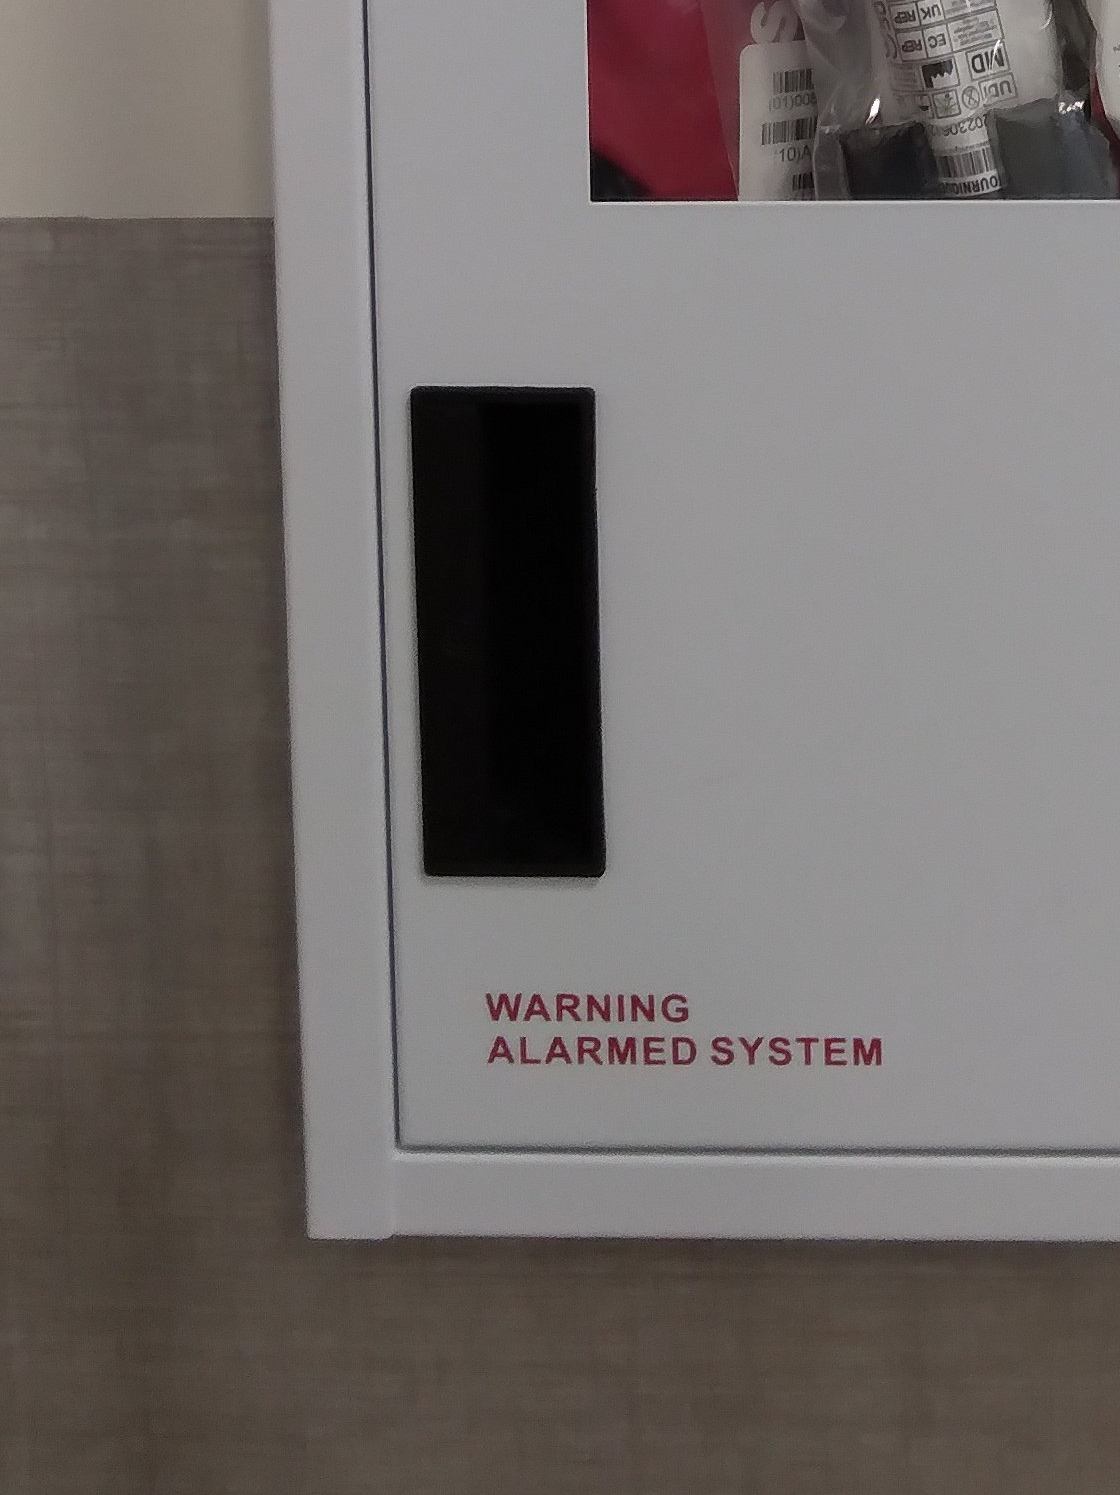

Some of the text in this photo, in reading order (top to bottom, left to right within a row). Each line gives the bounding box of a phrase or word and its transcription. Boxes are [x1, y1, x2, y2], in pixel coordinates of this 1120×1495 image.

[893, 10, 916, 24] REP
[920, 4, 941, 19] UK
[901, 39, 922, 53] REP
[927, 33, 946, 48] EC
[486, 993, 690, 1023] WARNING
[487, 1036, 882, 1066] ALARMED SYSTEM
